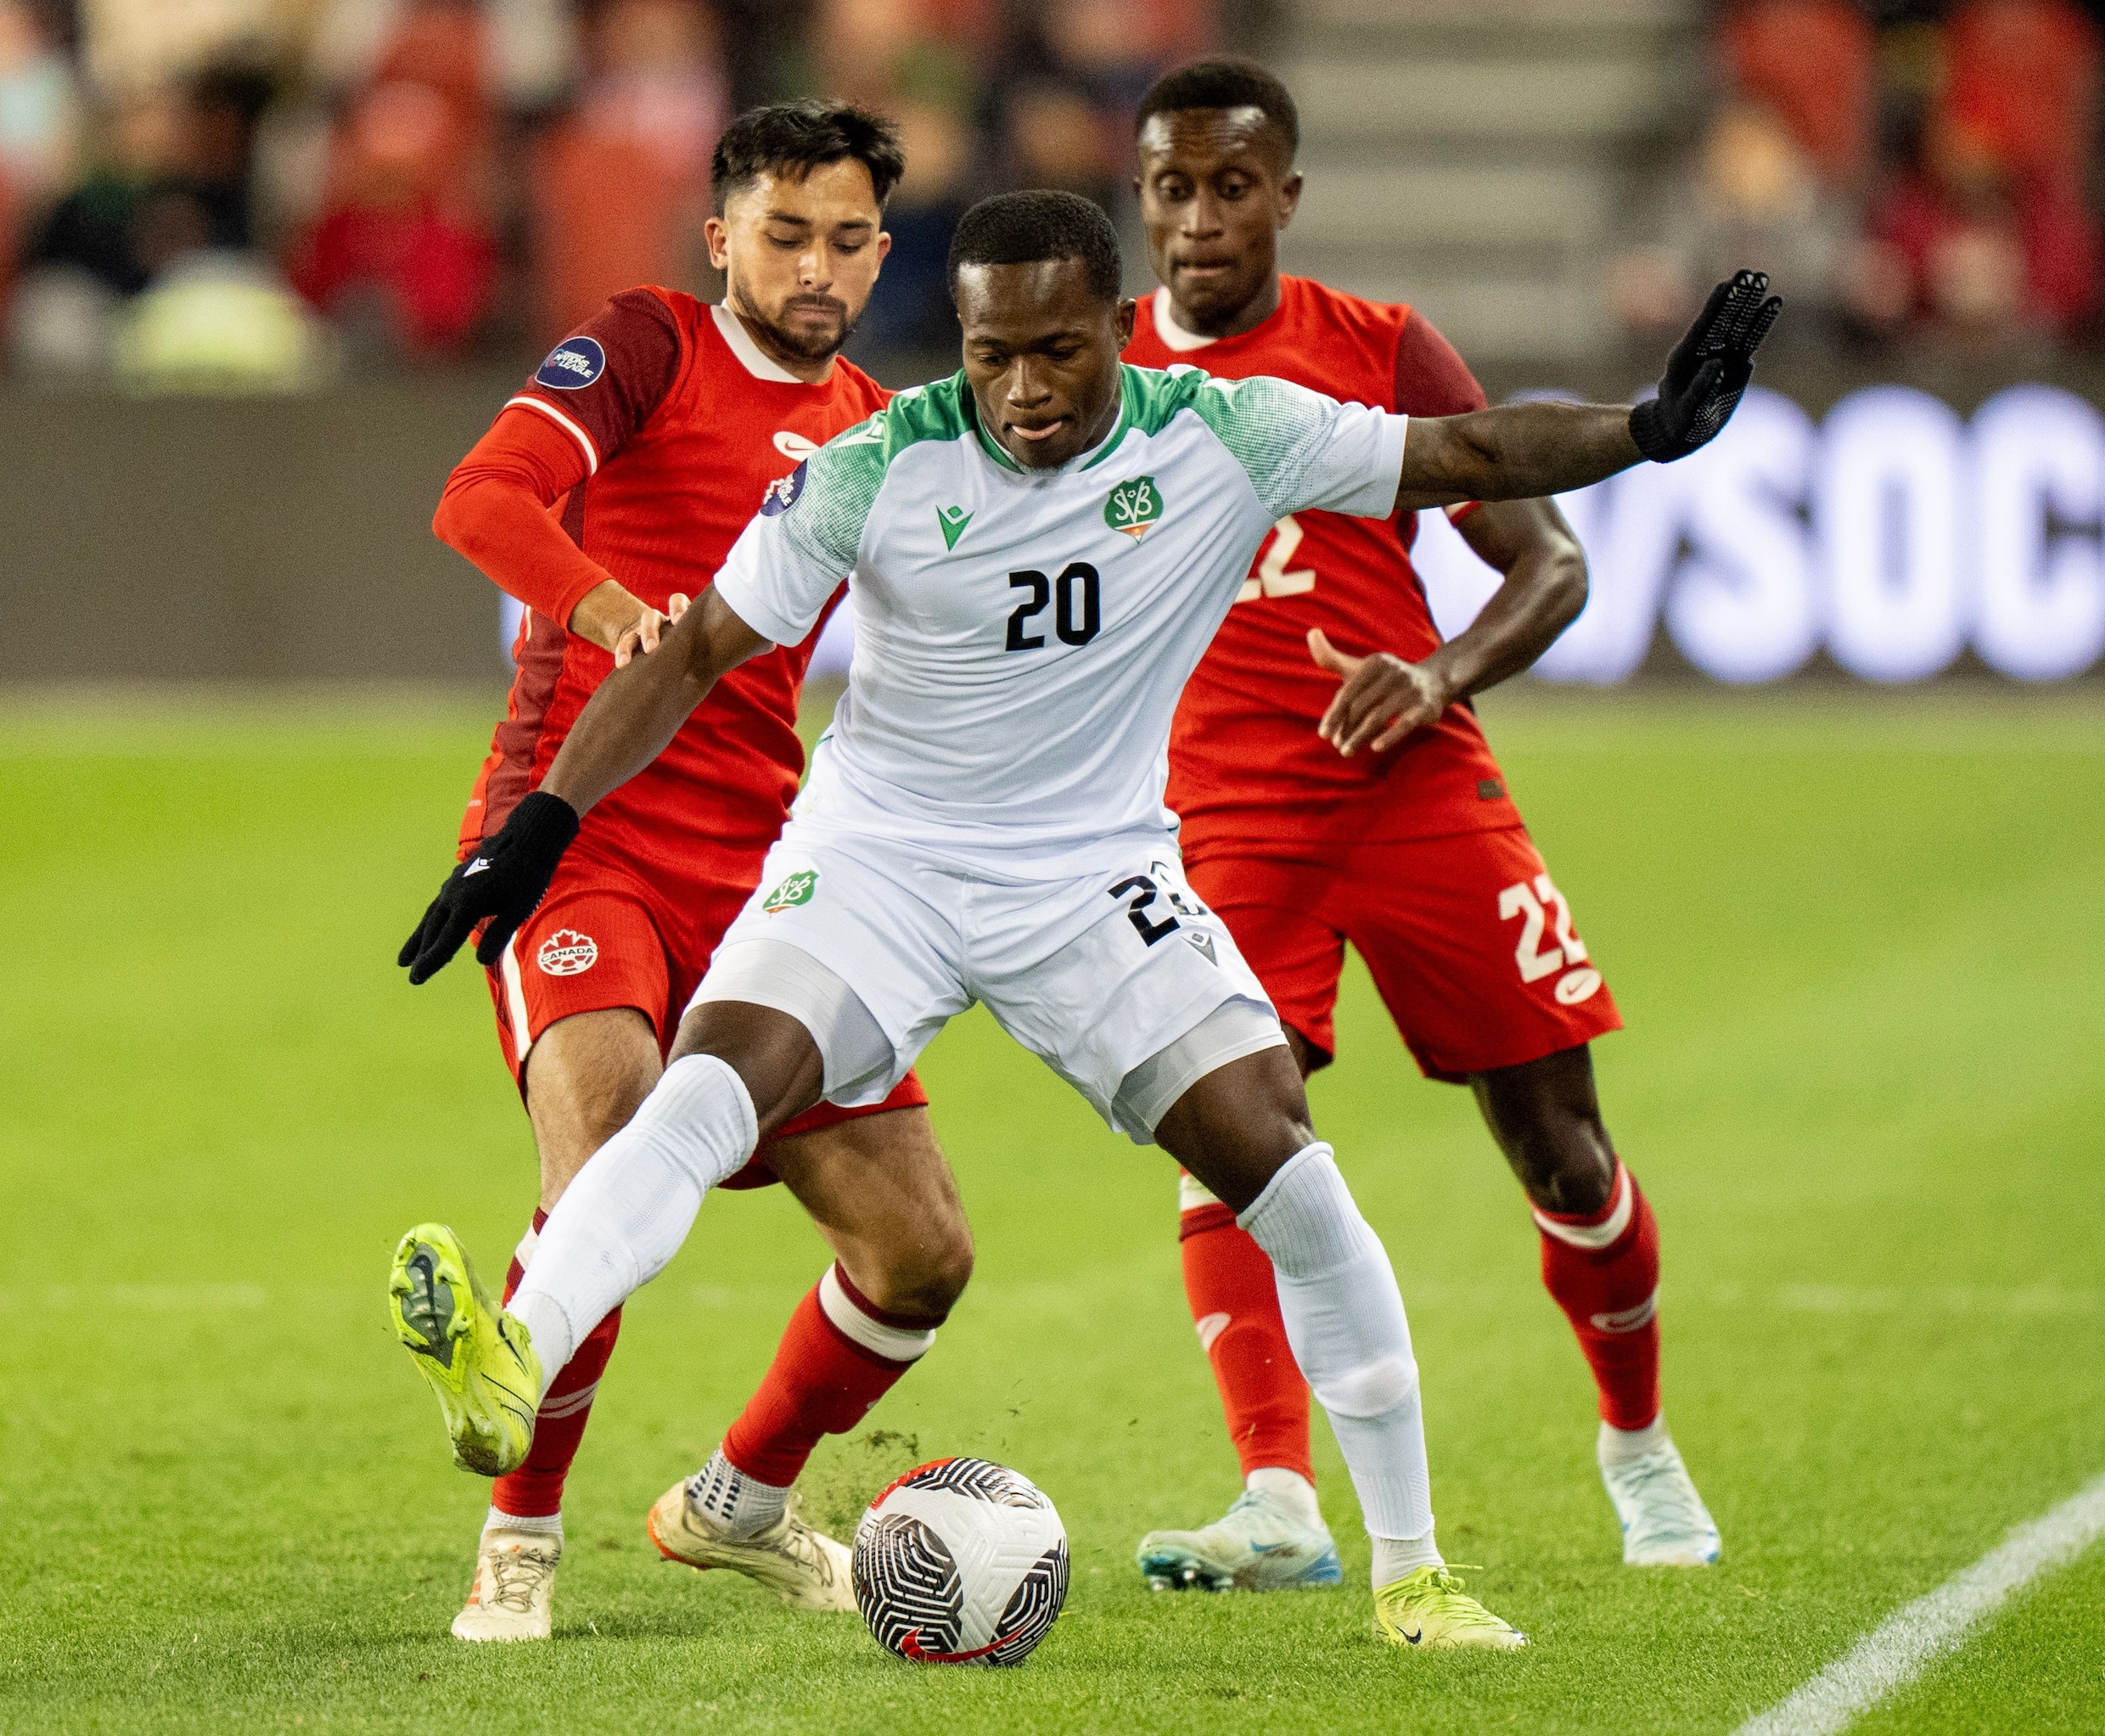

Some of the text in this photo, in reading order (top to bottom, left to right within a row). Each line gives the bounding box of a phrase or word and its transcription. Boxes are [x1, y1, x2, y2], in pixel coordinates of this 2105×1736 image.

[1006, 562, 1101, 651] 20
[541, 947, 594, 963] CANADA
[1497, 874, 1587, 984] 22
